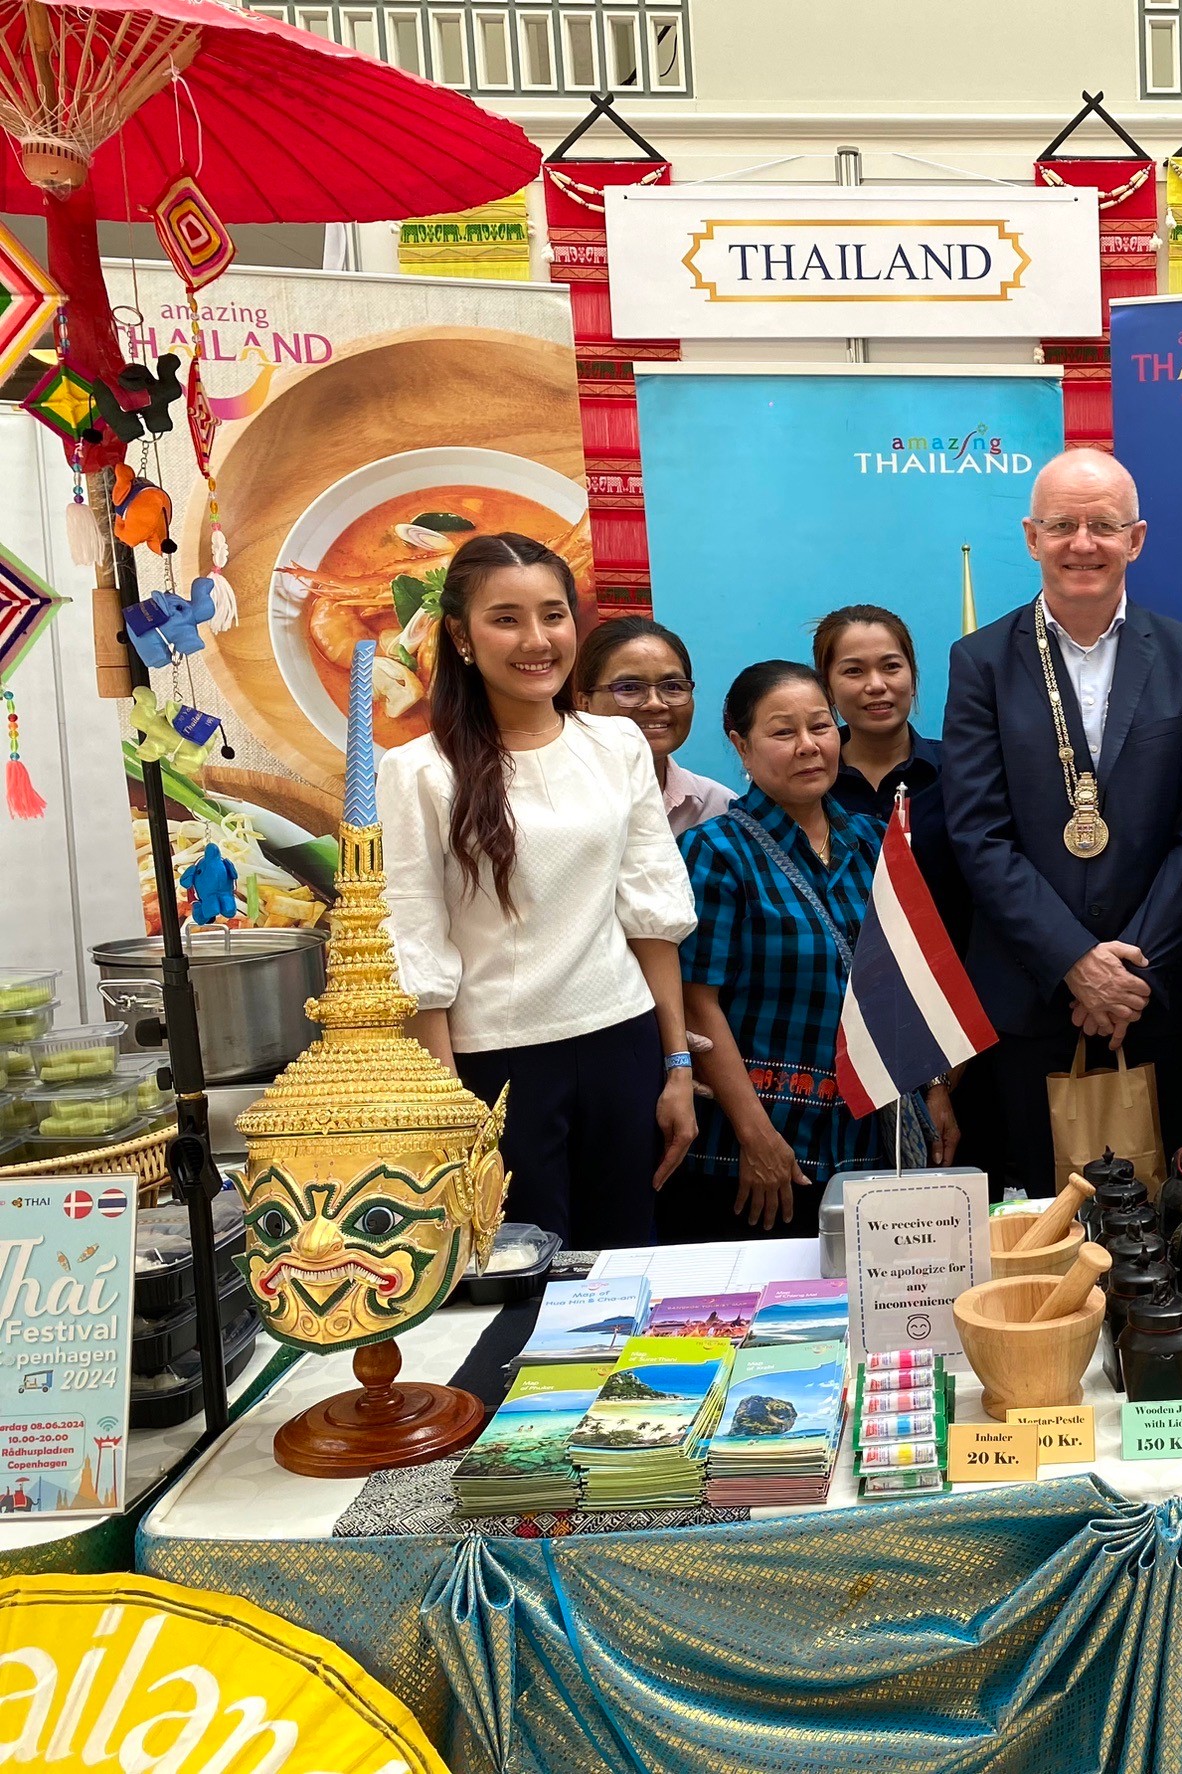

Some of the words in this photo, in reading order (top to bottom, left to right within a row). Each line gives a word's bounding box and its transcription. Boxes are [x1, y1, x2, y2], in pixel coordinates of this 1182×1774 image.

[728, 243, 992, 281] THAILAND
[892, 430, 1002, 456] amazing
[853, 452, 1033, 474] THAILAND
[24, 1197, 51, 1206] THAI
[867, 1221, 889, 1231] We
[891, 1219, 933, 1230] receive
[936, 1216, 961, 1230] only
[894, 1233, 936, 1246] CASH.
[867, 1268, 888, 1278] We
[890, 1264, 946, 1279] apologize
[948, 1263, 966, 1272] for
[906, 1283, 928, 1293] any
[5, 1314, 118, 1344] Festival
[60, 1366, 118, 1390] 2024
[1135, 1406, 1174, 1414] Wooden
[30, 1421, 84, 1430] 08.06.2024
[1144, 1419, 1165, 1428] with
[8, 1434, 69, 1443] 10.00-20.00
[975, 1433, 1013, 1442] Inhaler
[1058, 1434, 1082, 1447] Kr.
[1137, 1438, 1165, 1451] 150
[1, 1446, 74, 1457] Rådhuspladsen
[967, 1452, 989, 1464] 20
[994, 1451, 1019, 1464] Kr.
[7, 1460, 68, 1470] Copenhagen
